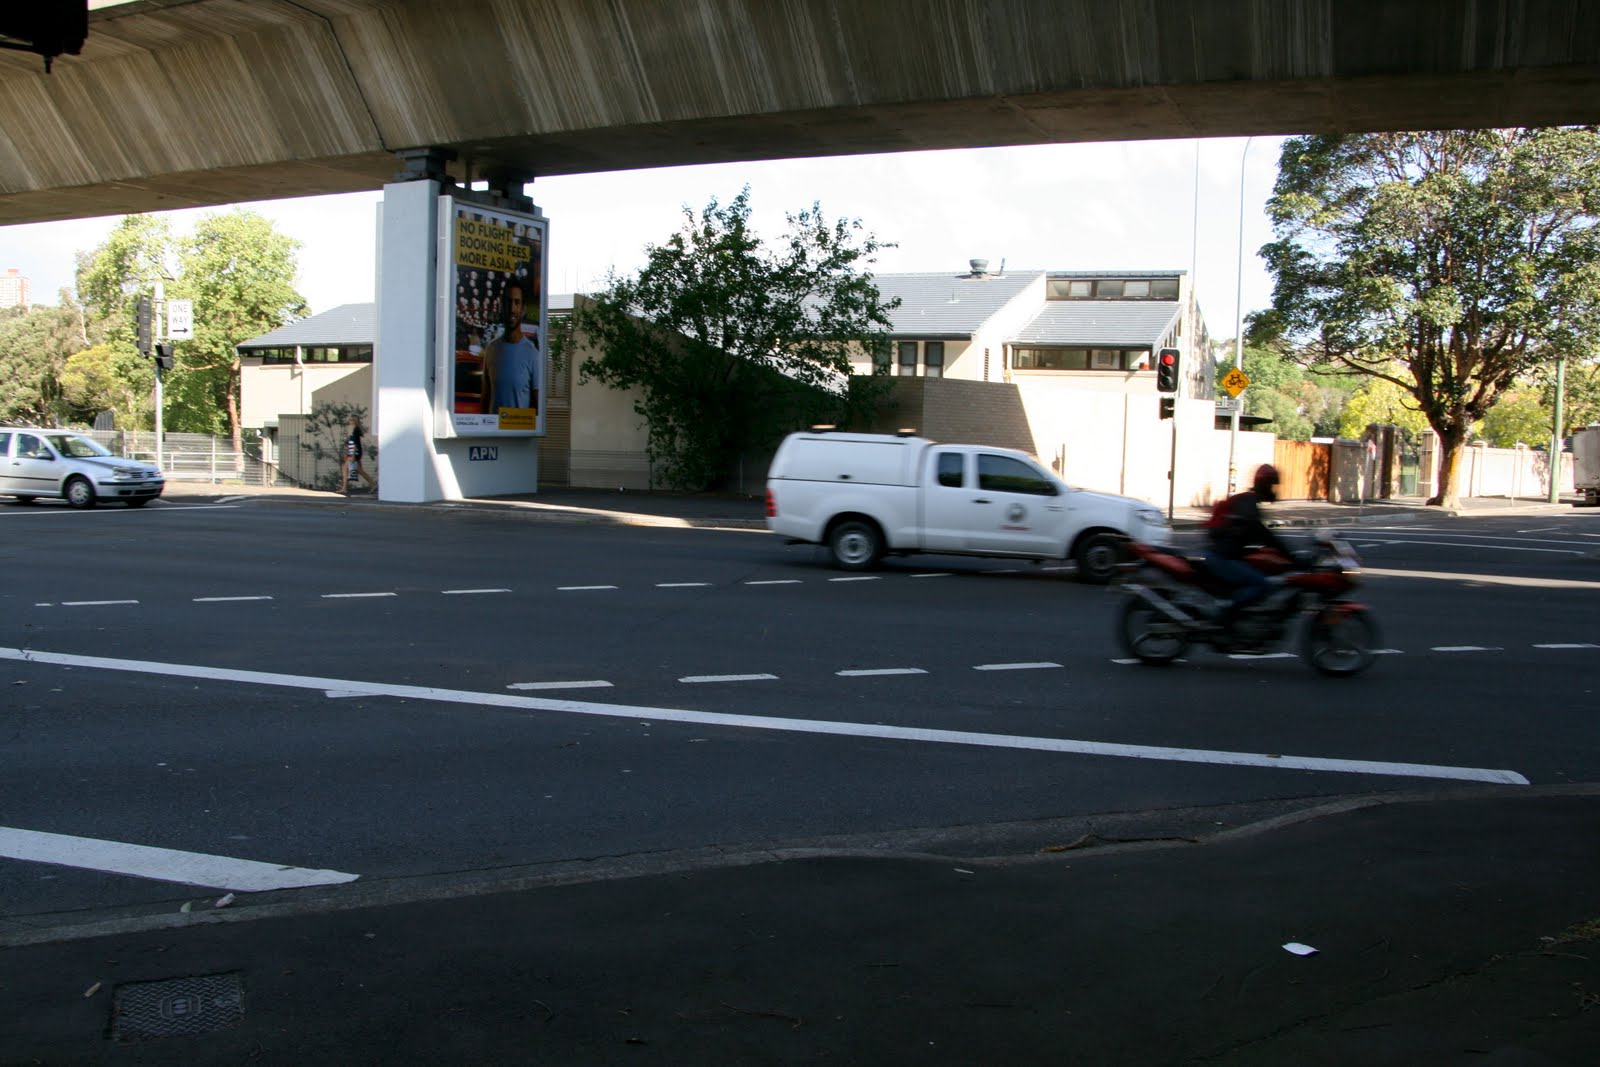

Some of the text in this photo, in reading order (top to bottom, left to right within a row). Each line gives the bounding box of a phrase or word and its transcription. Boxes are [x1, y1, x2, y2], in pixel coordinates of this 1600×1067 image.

[460, 221, 511, 241] NO FLIGHT
[460, 236, 504, 255] BOOKING
[460, 252, 487, 267] MORE
[172, 304, 188, 313] ONE
[172, 316, 188, 325] WAY
[471, 447, 497, 460] APN
